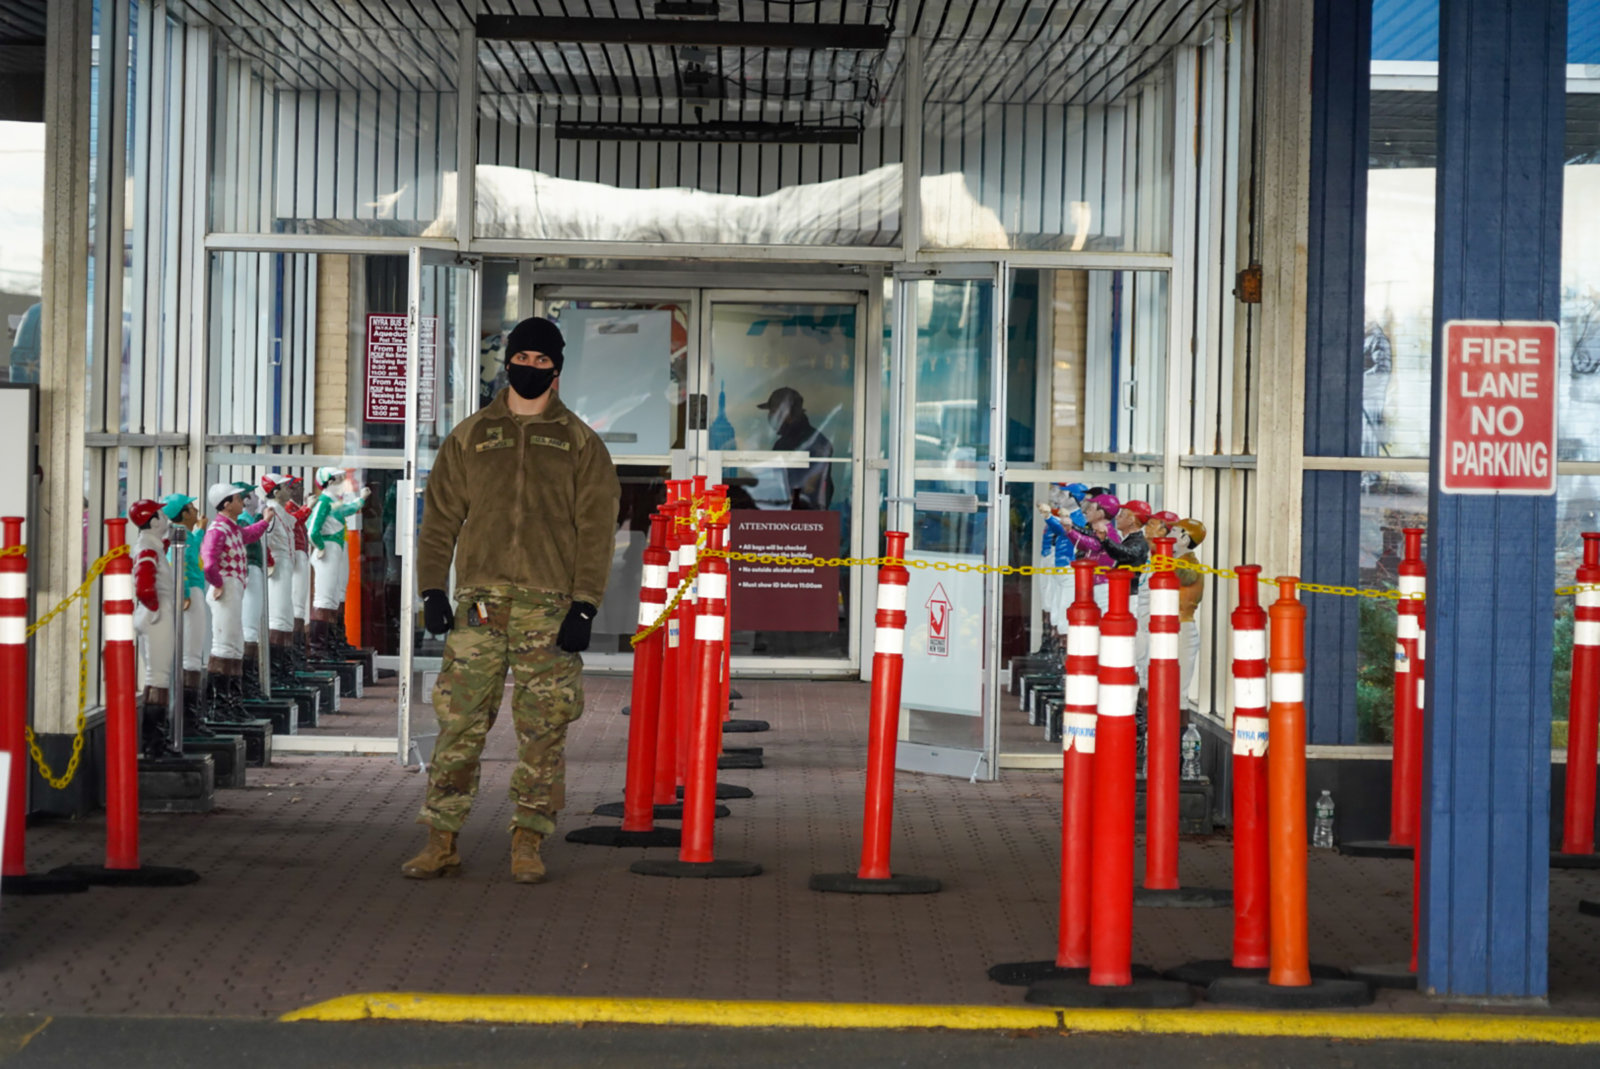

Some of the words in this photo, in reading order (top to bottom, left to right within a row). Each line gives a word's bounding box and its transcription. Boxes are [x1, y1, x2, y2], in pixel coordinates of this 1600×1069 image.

[373, 330, 409, 338] Aqueduc
[373, 345, 394, 353] From
[1461, 337, 1541, 365] FIRE
[1461, 371, 1538, 398] LANE
[1471, 405, 1524, 436] NO
[1452, 441, 1548, 478] PARKING
[738, 522, 790, 531] ATTENTION
[790, 523, 824, 531] GUESTS
[751, 543, 765, 551] bags
